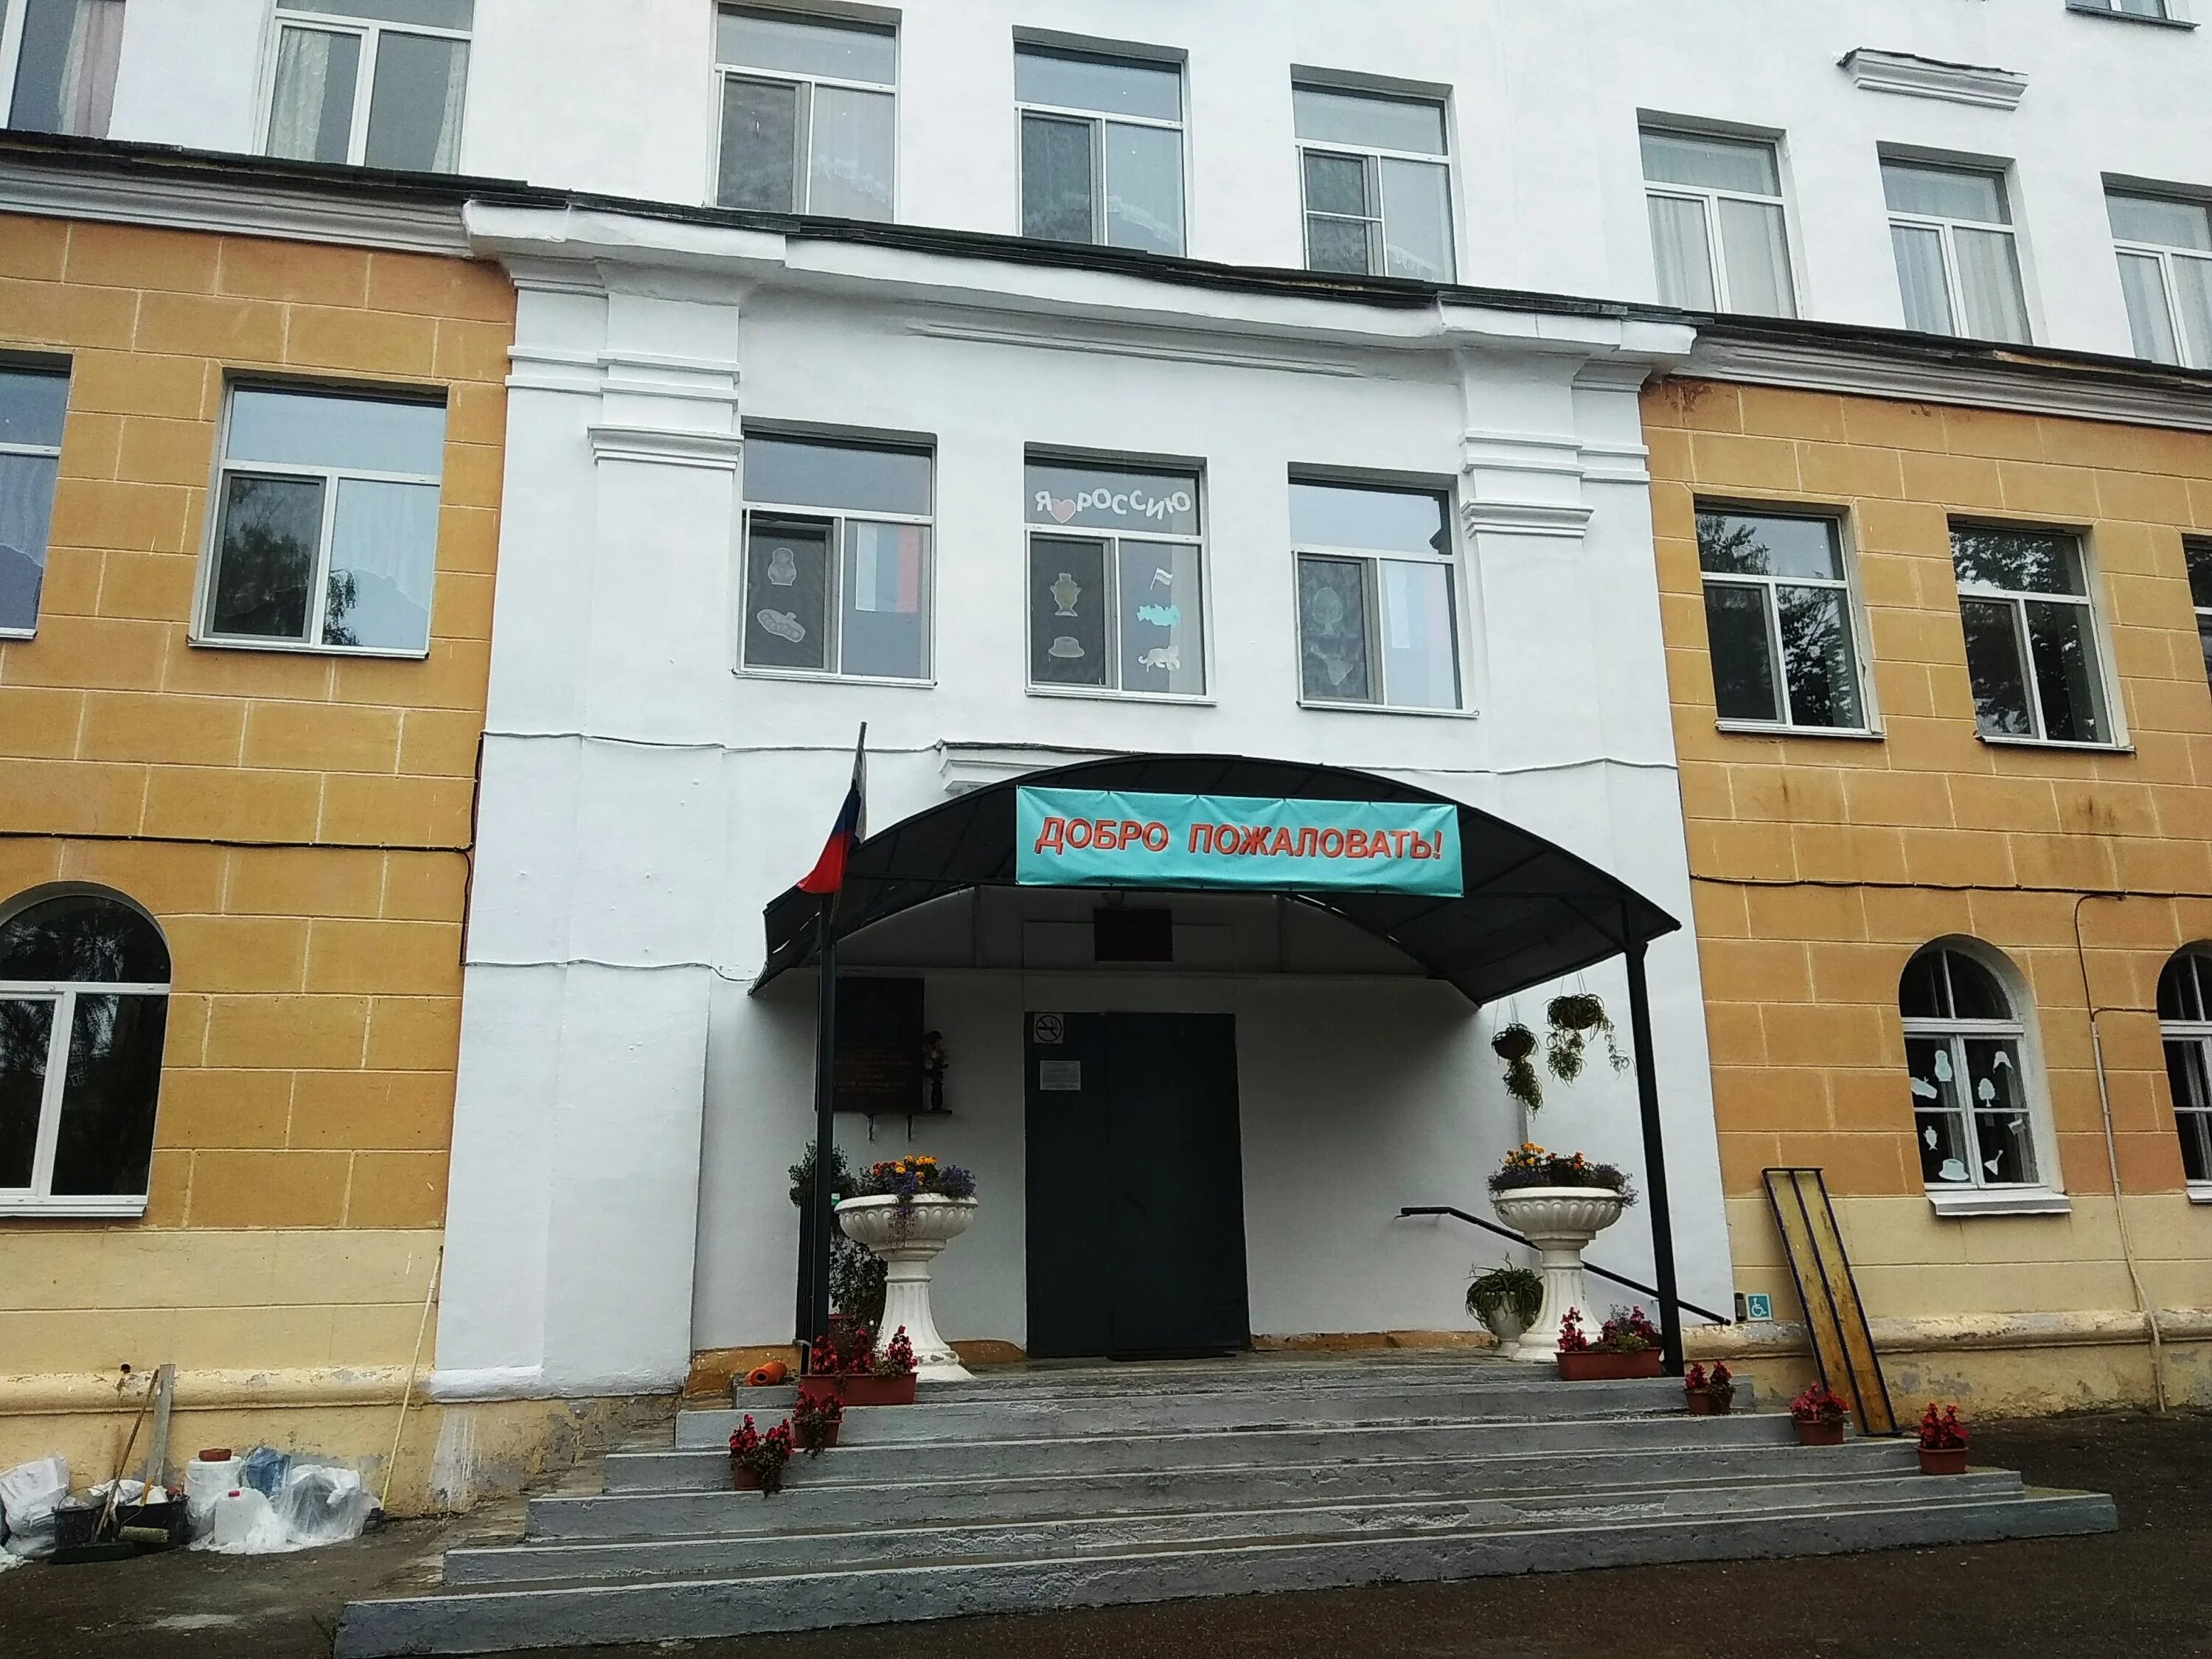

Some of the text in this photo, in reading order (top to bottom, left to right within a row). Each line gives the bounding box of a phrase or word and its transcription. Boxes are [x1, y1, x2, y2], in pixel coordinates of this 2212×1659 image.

[1034, 487, 1192, 521] Я РОССИЮ
[1034, 816, 1443, 860] ДОБРО ПОЖАЛОВАТЬ!
